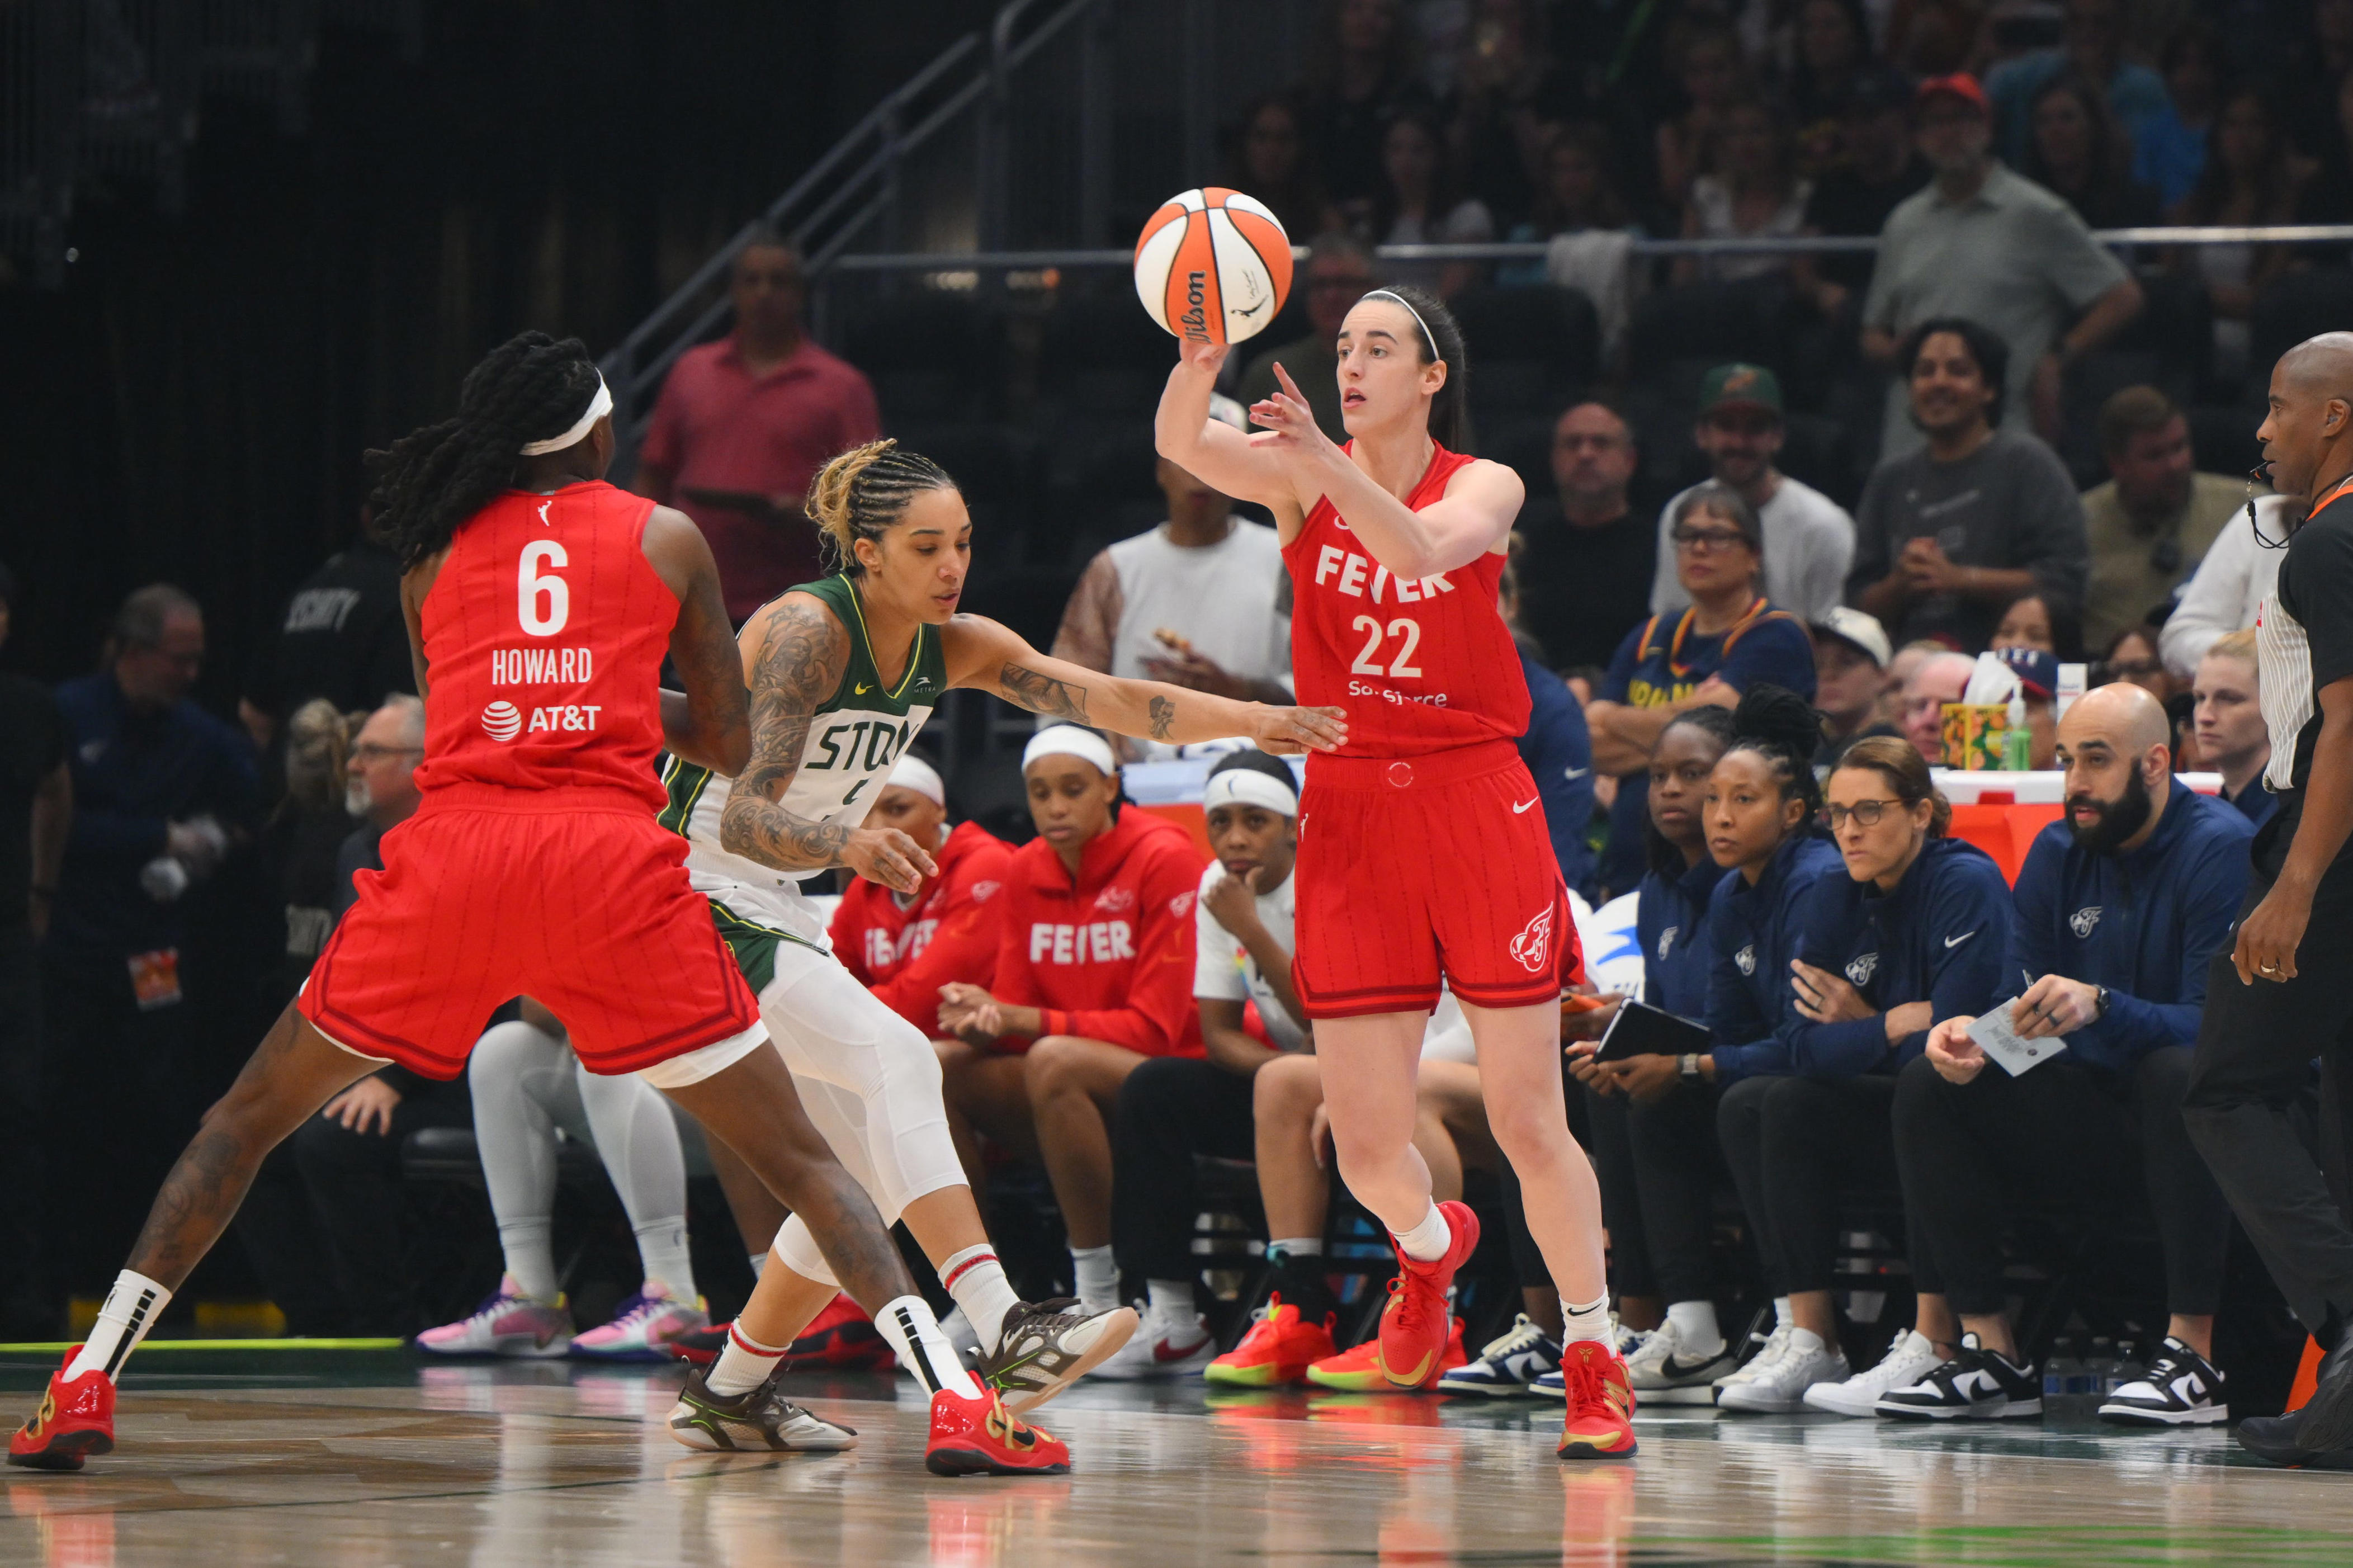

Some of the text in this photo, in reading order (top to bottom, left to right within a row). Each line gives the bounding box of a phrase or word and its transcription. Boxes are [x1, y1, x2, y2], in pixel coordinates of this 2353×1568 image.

[517, 539, 569, 636] 6
[492, 648, 592, 685] HOWARD
[1351, 615, 1421, 677] 22
[527, 705, 602, 734] AT&T
